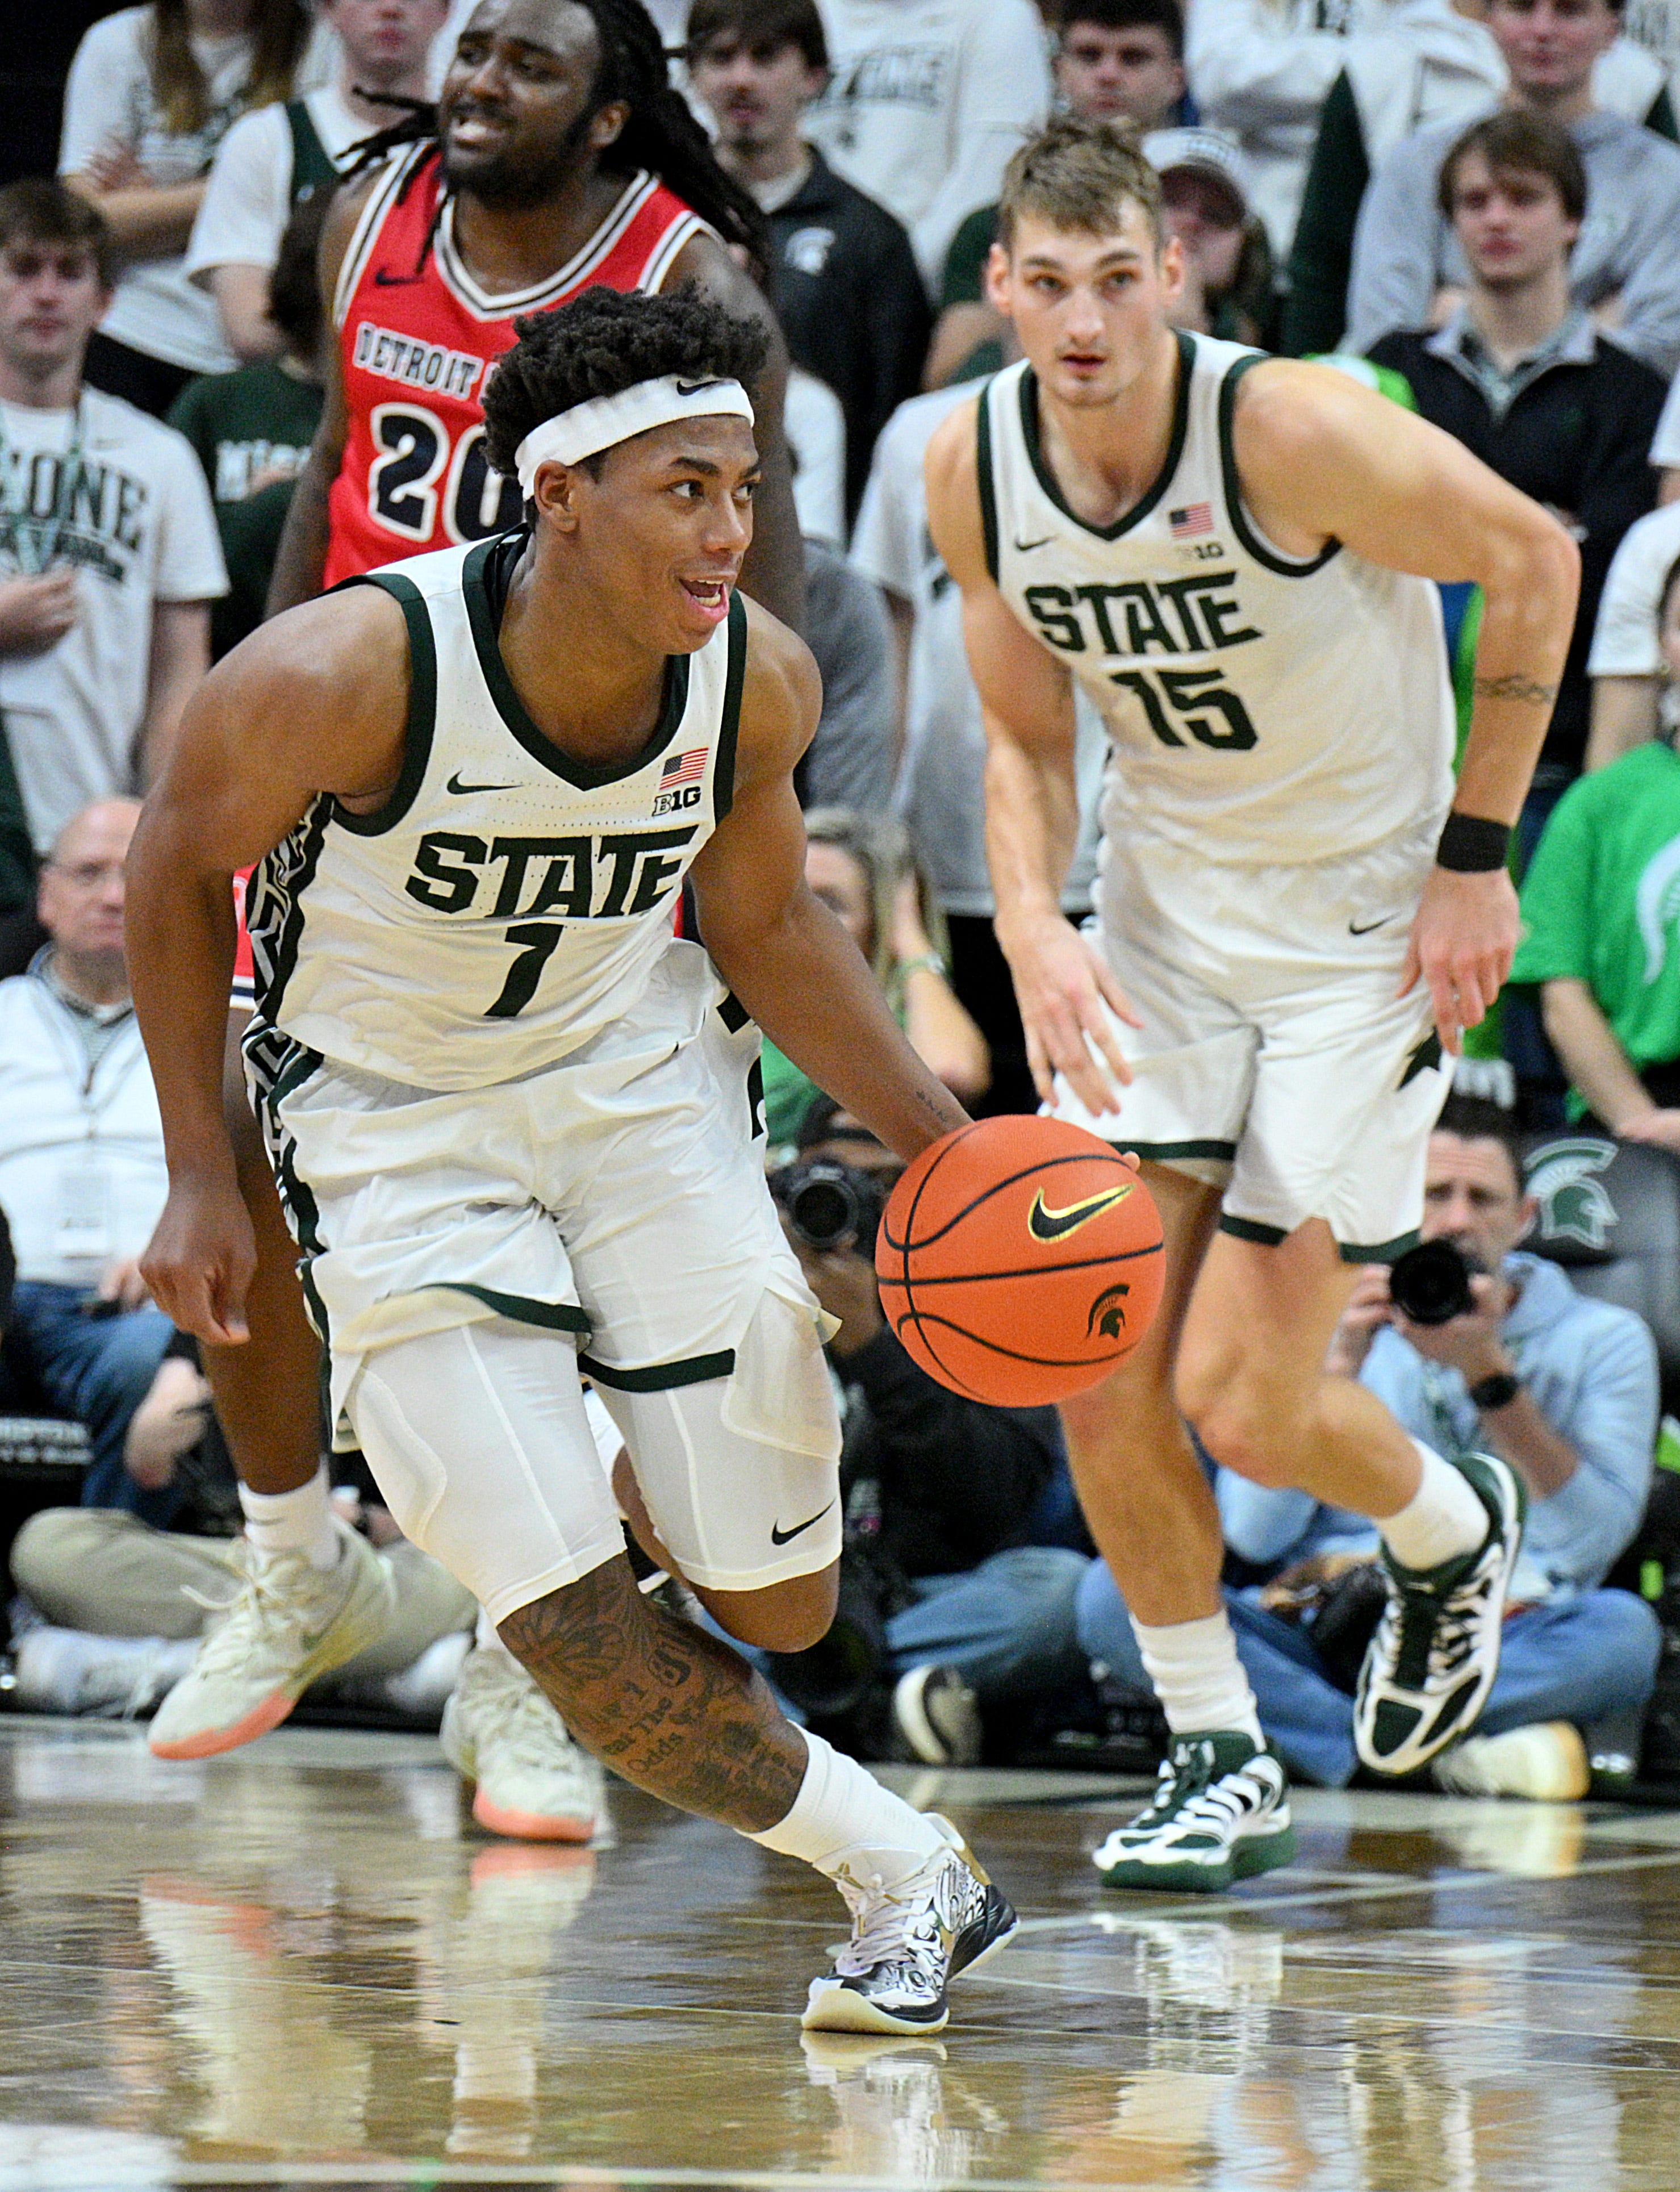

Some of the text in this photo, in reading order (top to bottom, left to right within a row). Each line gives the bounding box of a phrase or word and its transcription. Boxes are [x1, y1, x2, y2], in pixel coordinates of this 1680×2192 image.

[368, 402, 527, 544] 20
[1024, 570, 1264, 654] STATE
[1109, 669, 1259, 751] 15
[404, 824, 700, 918] STATE
